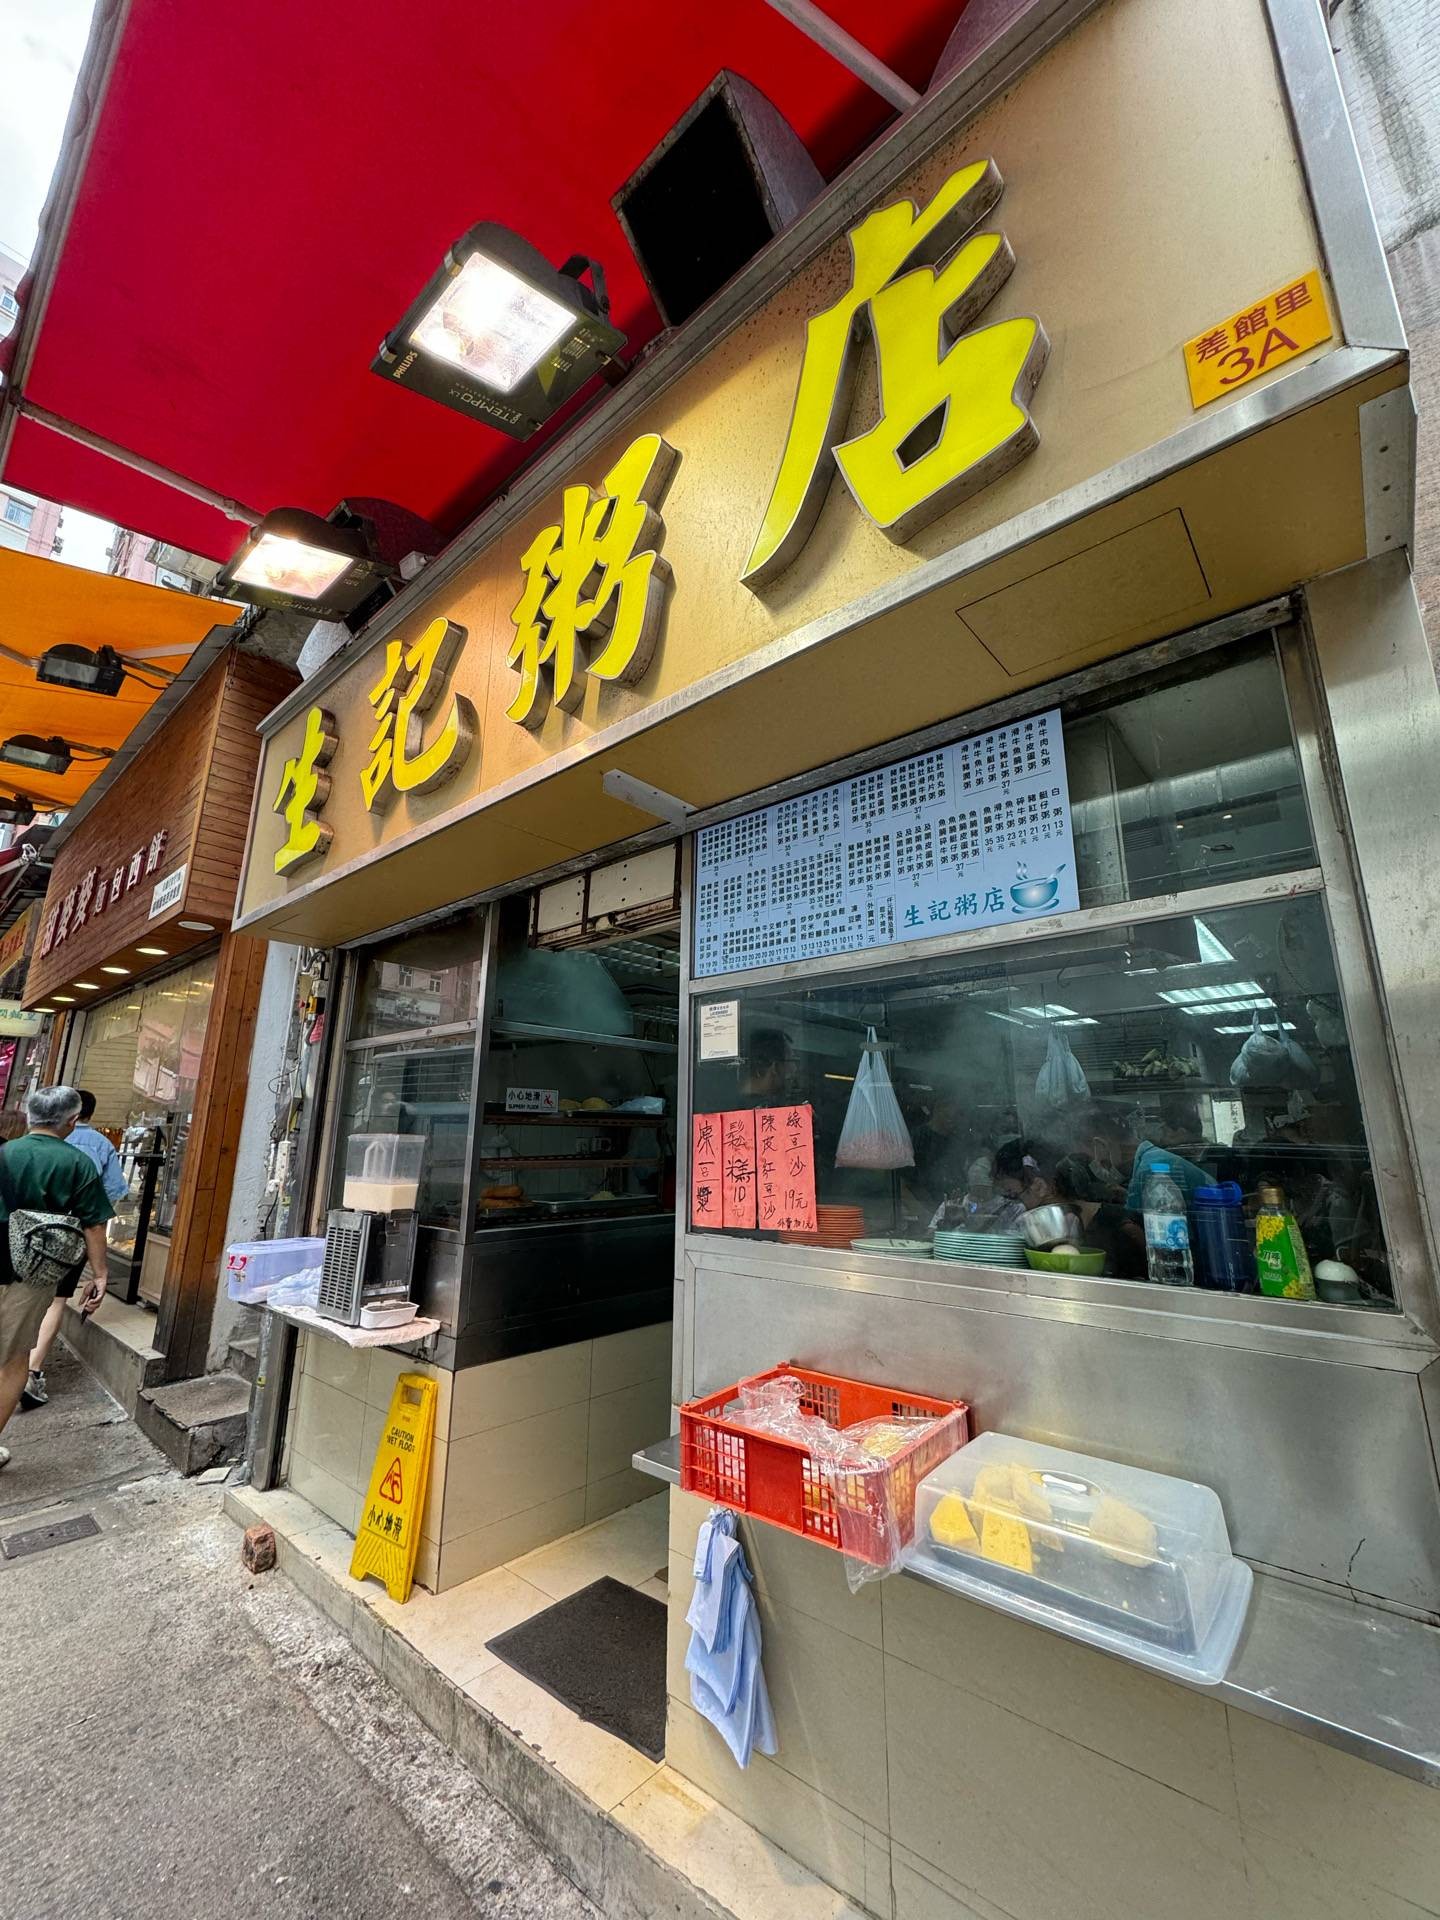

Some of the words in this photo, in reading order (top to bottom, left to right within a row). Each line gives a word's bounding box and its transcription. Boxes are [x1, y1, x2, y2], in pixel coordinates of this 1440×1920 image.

[1196, 281, 1312, 363] 差館里
[393, 351, 418, 378] PHILIPS
[1217, 327, 1299, 385] 3A
[274, 158, 1042, 875] 生記粥店
[904, 887, 1005, 928] 生記粥店
[760, 1115, 777, 1220] 陳皮紅豆沙
[784, 1189, 808, 1211] 19元
[391, 1426, 414, 1443] CAUTION
[368, 1504, 402, 1541] 小心地滑
